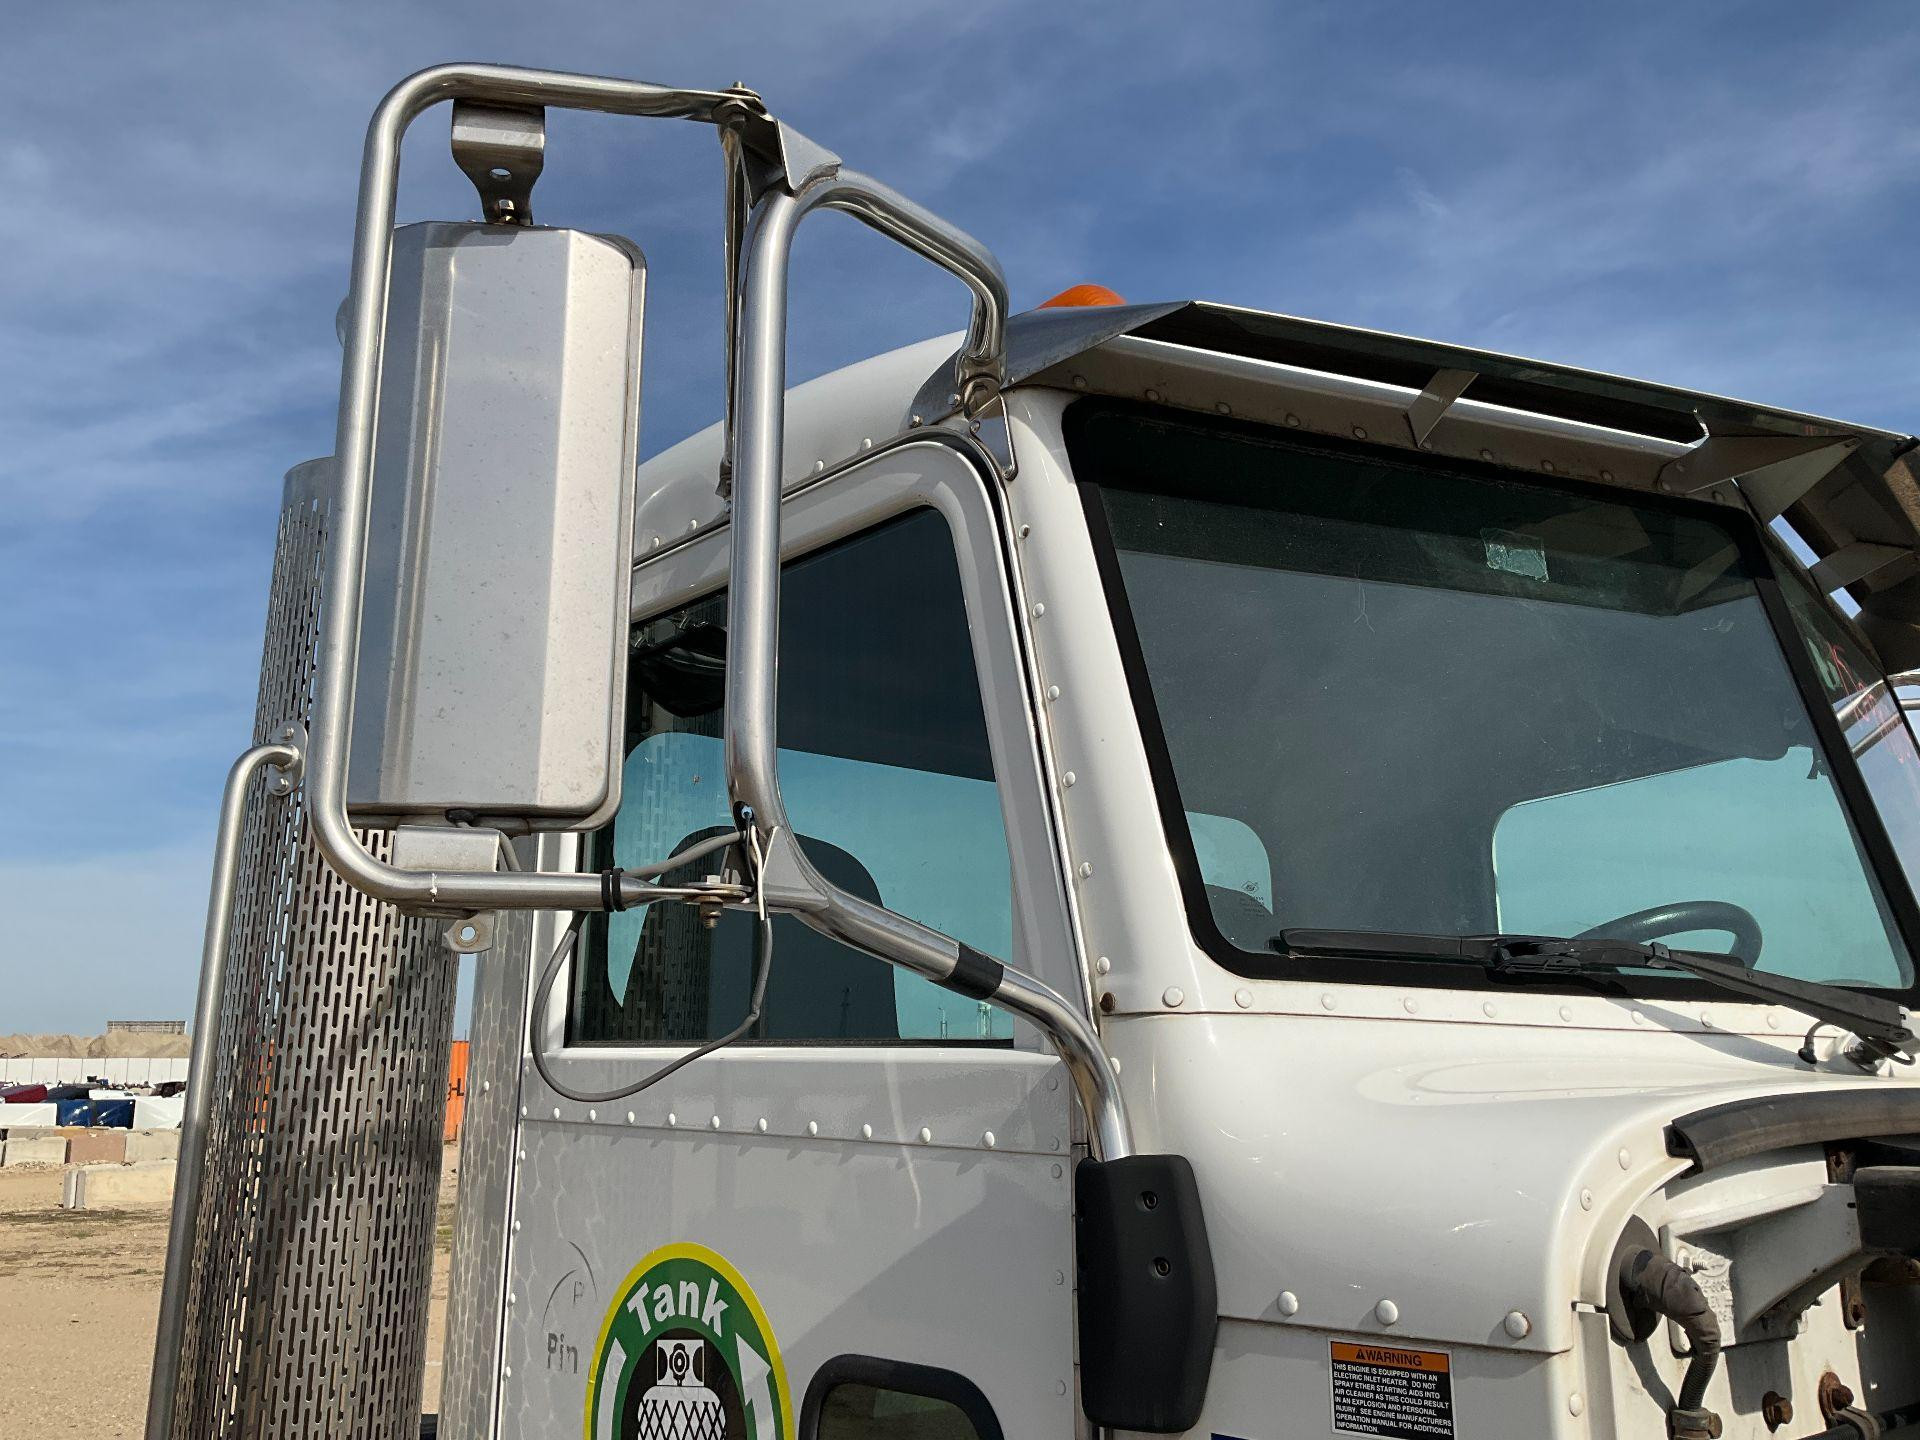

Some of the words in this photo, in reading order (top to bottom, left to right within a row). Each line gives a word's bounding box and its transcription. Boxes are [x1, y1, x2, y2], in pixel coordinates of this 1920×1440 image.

[626, 1277, 729, 1338] Tank
[547, 1332, 578, 1374] Pin
[1366, 1350, 1423, 1366] WARNING
[1348, 1364, 1370, 1373] ENGINE
[1379, 1368, 1409, 1378] EQUIPPED
[1334, 1372, 1362, 1380] ELECTRIC
[1382, 1378, 1408, 1386] HEATER.
[1423, 1382, 1435, 1390] NOT
[1334, 1380, 1353, 1388] SPRAY
[1356, 1382, 1375, 1390] ETHER
[1377, 1385, 1407, 1395] STARTING
[1346, 1390, 1373, 1399] CLEANER
[1401, 1397, 1422, 1405] COULD
[1424, 1400, 1449, 1409] RESULT
[1352, 1399, 1386, 1409] EXPLOSION
[1388, 1403, 1401, 1411] AND
[1403, 1405, 1437, 1416] PERSONAL
[1336, 1413, 1370, 1423] OPERATION
[1372, 1417, 1398, 1427] MANUAL
[1399, 1421, 1412, 1429] FOR
[1414, 1424, 1452, 1435] ADDITIONAL
[1373, 1410, 1395, 1419] ENGINE
[1397, 1413, 1451, 1426] MANUFACTURERS
